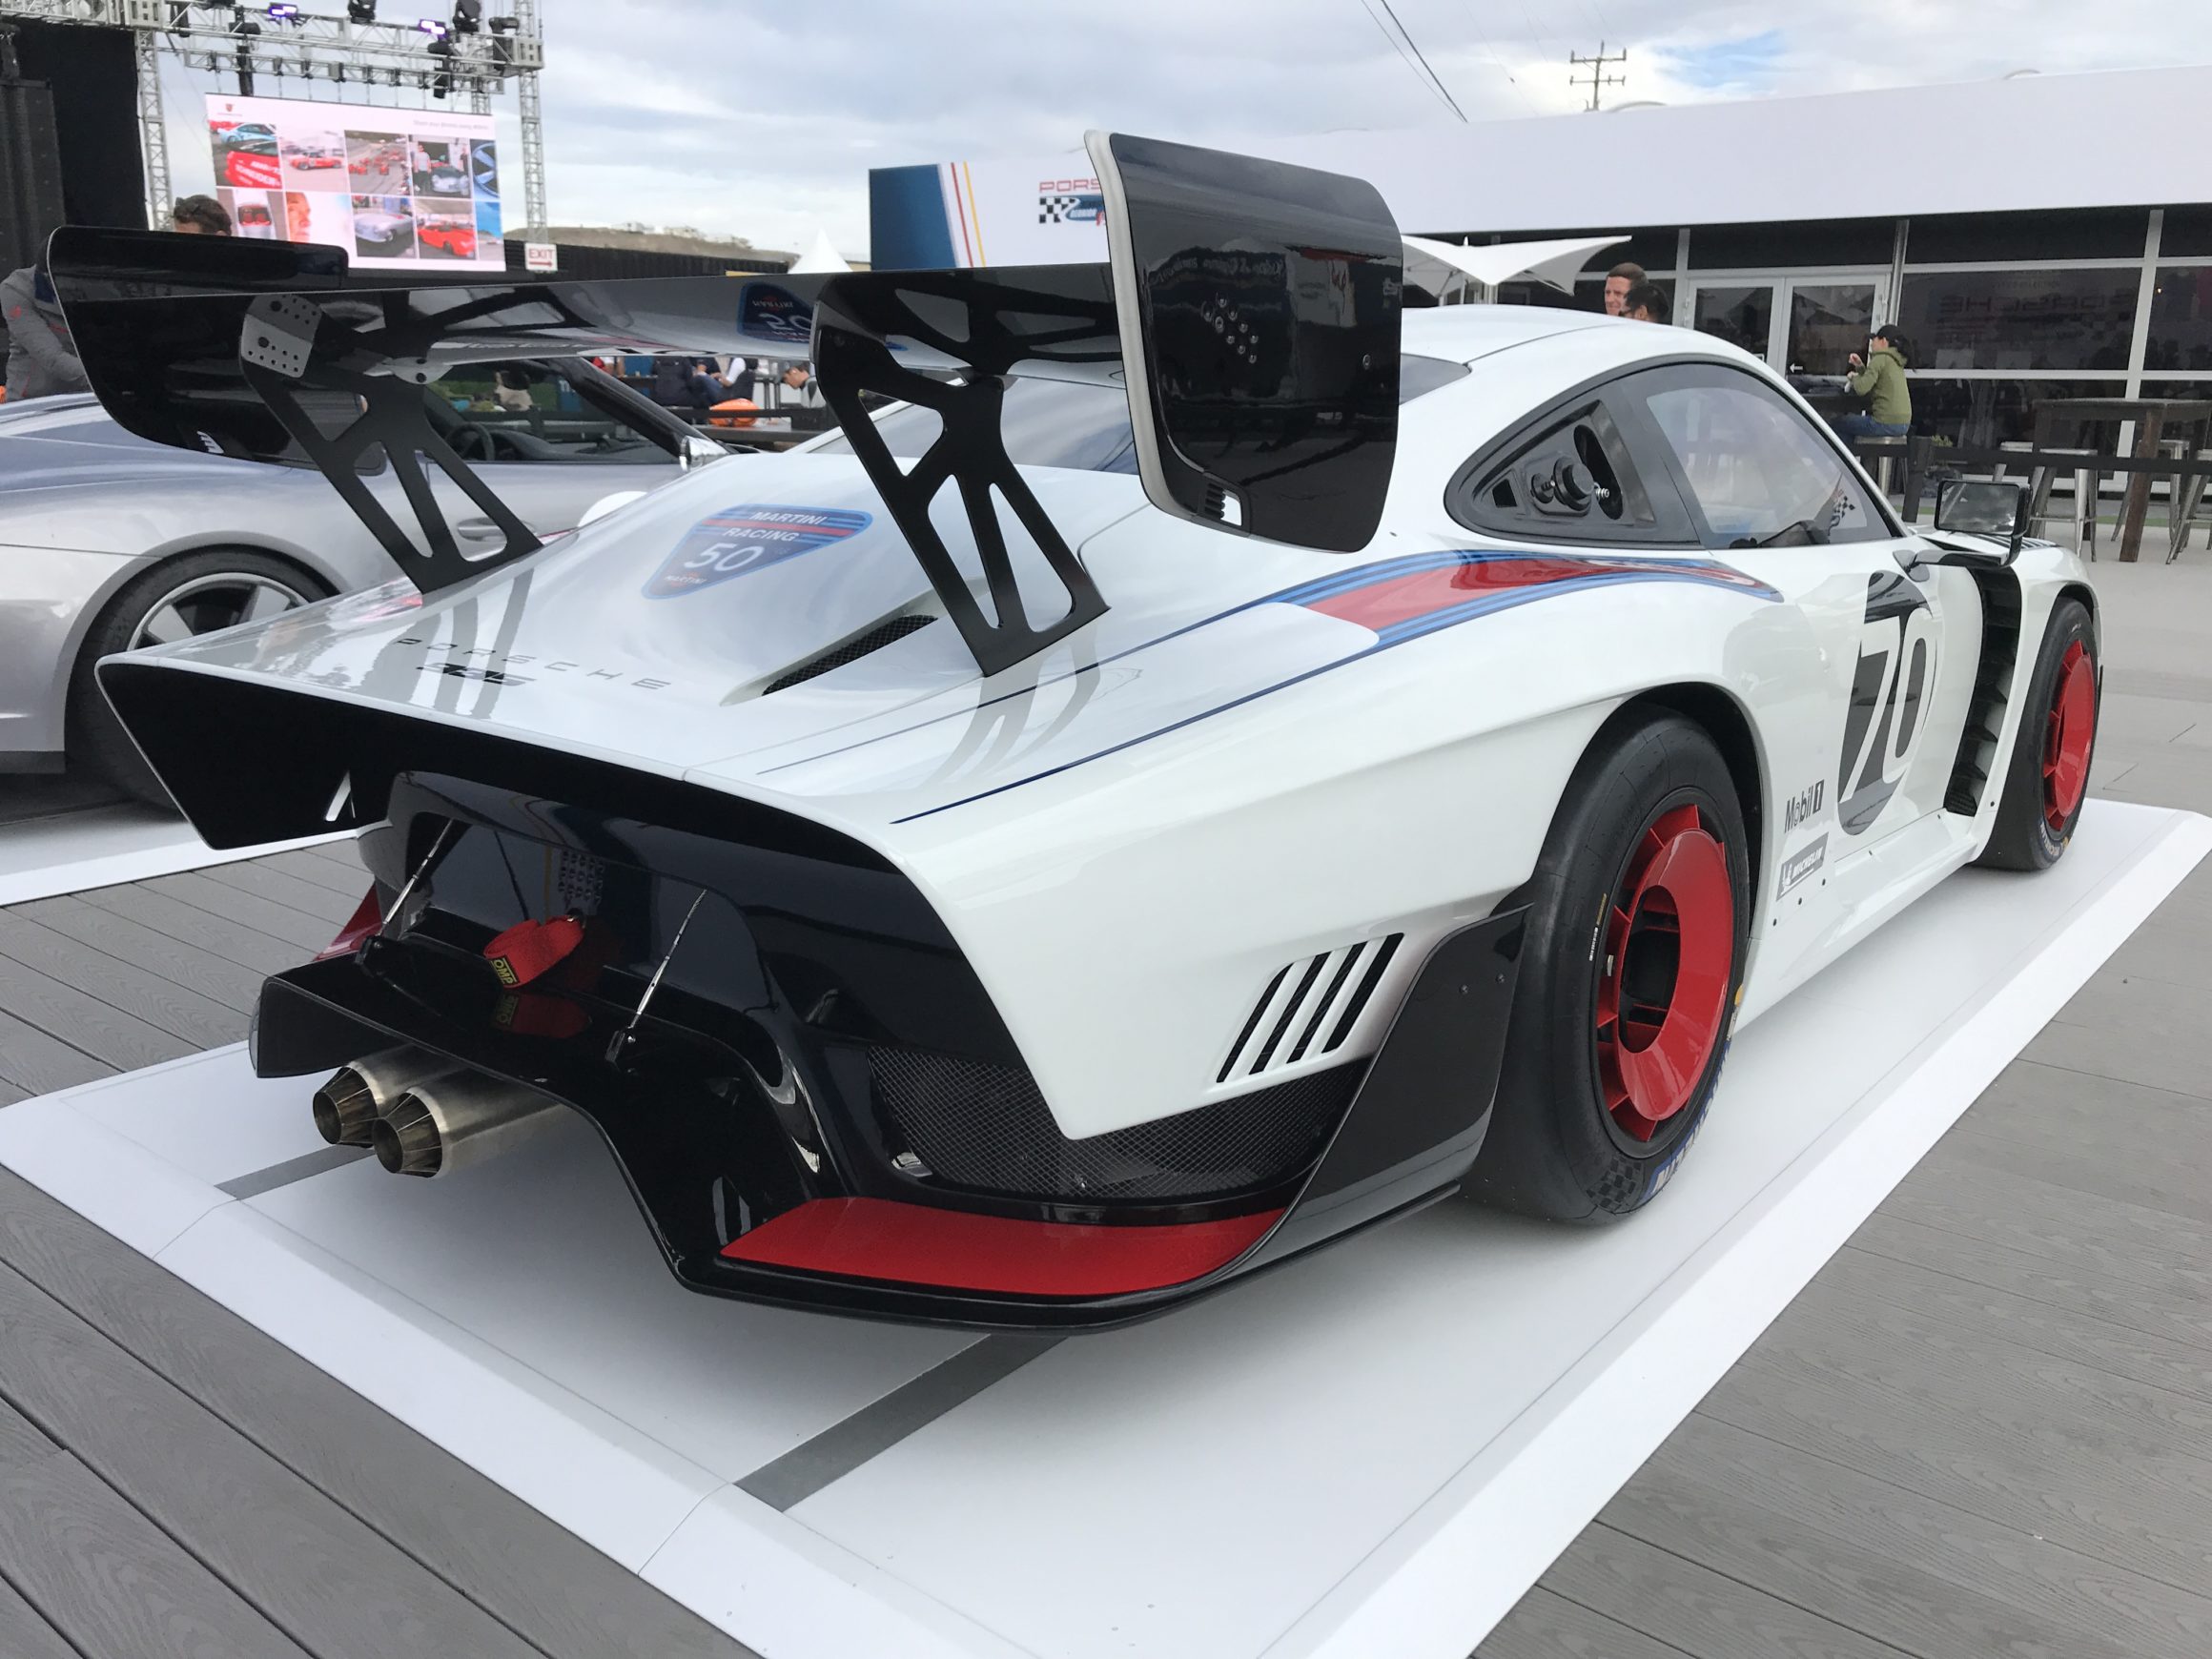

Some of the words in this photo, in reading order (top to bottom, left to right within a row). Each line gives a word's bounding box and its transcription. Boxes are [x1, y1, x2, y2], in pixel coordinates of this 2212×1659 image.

[528, 248, 553, 259] EXIT
[748, 511, 828, 525] MARTINI
[722, 527, 801, 542] RACING
[684, 543, 766, 571] 50
[664, 574, 707, 584] MARTINI
[394, 638, 671, 689] PORSCHE
[1837, 607, 1938, 804] 70
[1784, 785, 1814, 833] Mobil
[1813, 780, 1824, 813] 1
[1792, 846, 1824, 880] MICHELIN
[493, 959, 514, 984] OMP
